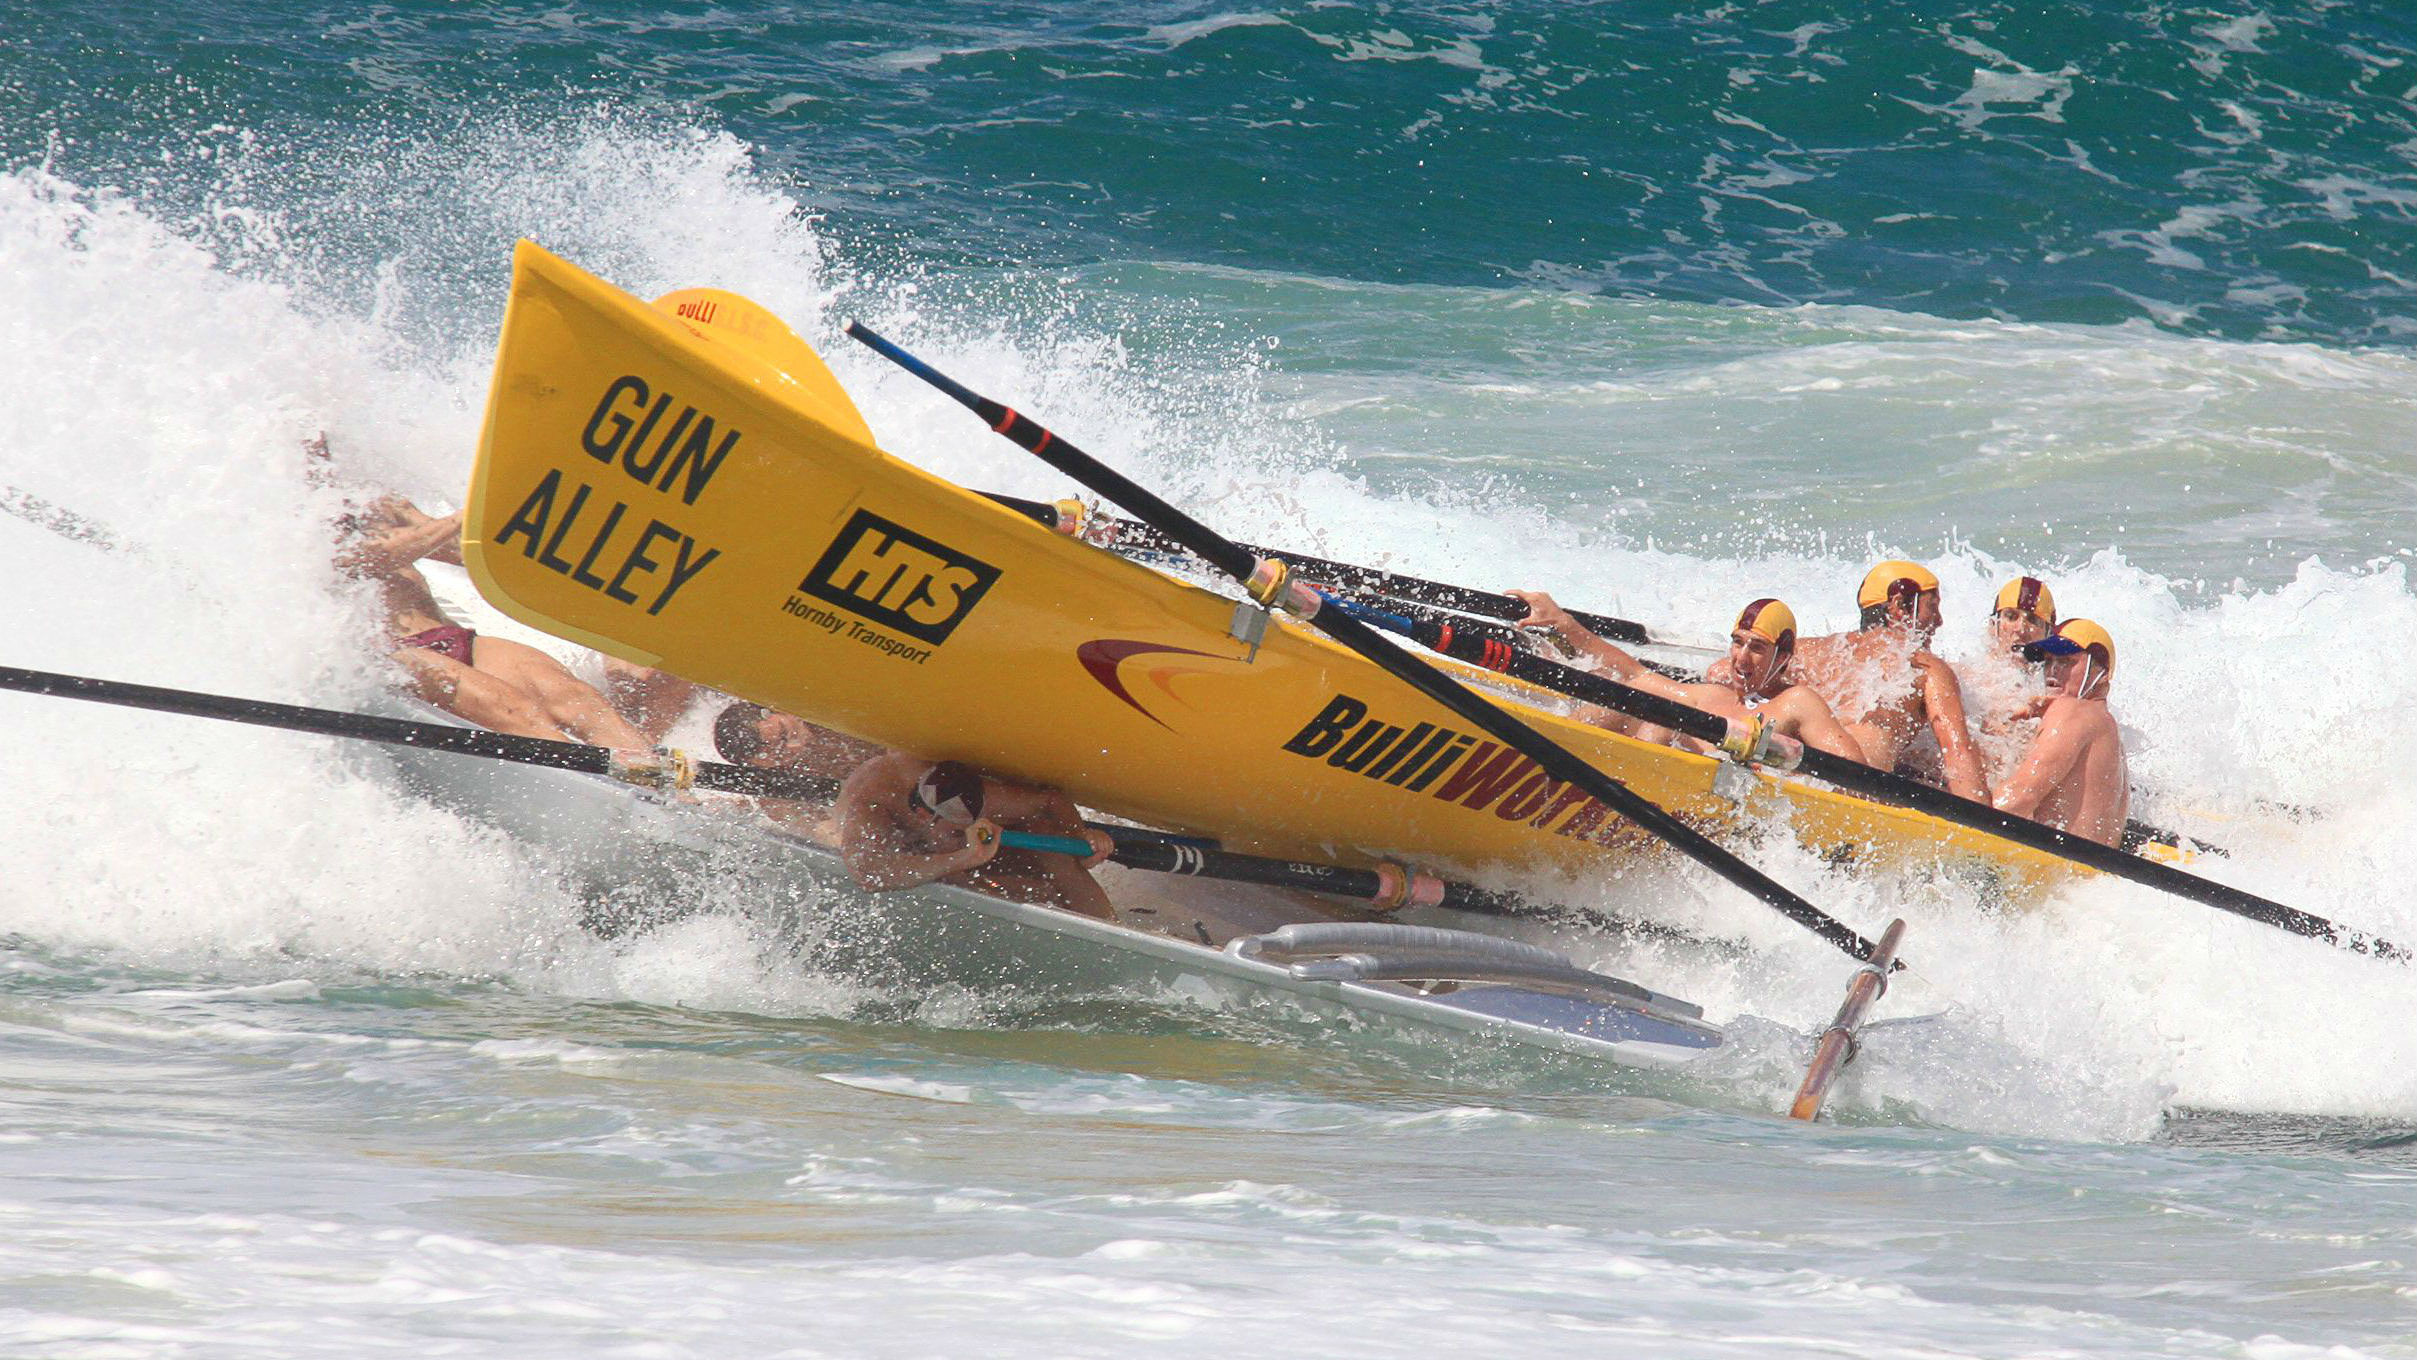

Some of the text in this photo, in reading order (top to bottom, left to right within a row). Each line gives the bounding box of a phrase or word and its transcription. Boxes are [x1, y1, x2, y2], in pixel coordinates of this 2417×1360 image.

[581, 375, 742, 506] GUN
[493, 468, 722, 616] ALLEY
[826, 527, 979, 625] HTS
[781, 595, 932, 665] Hornby Transport
